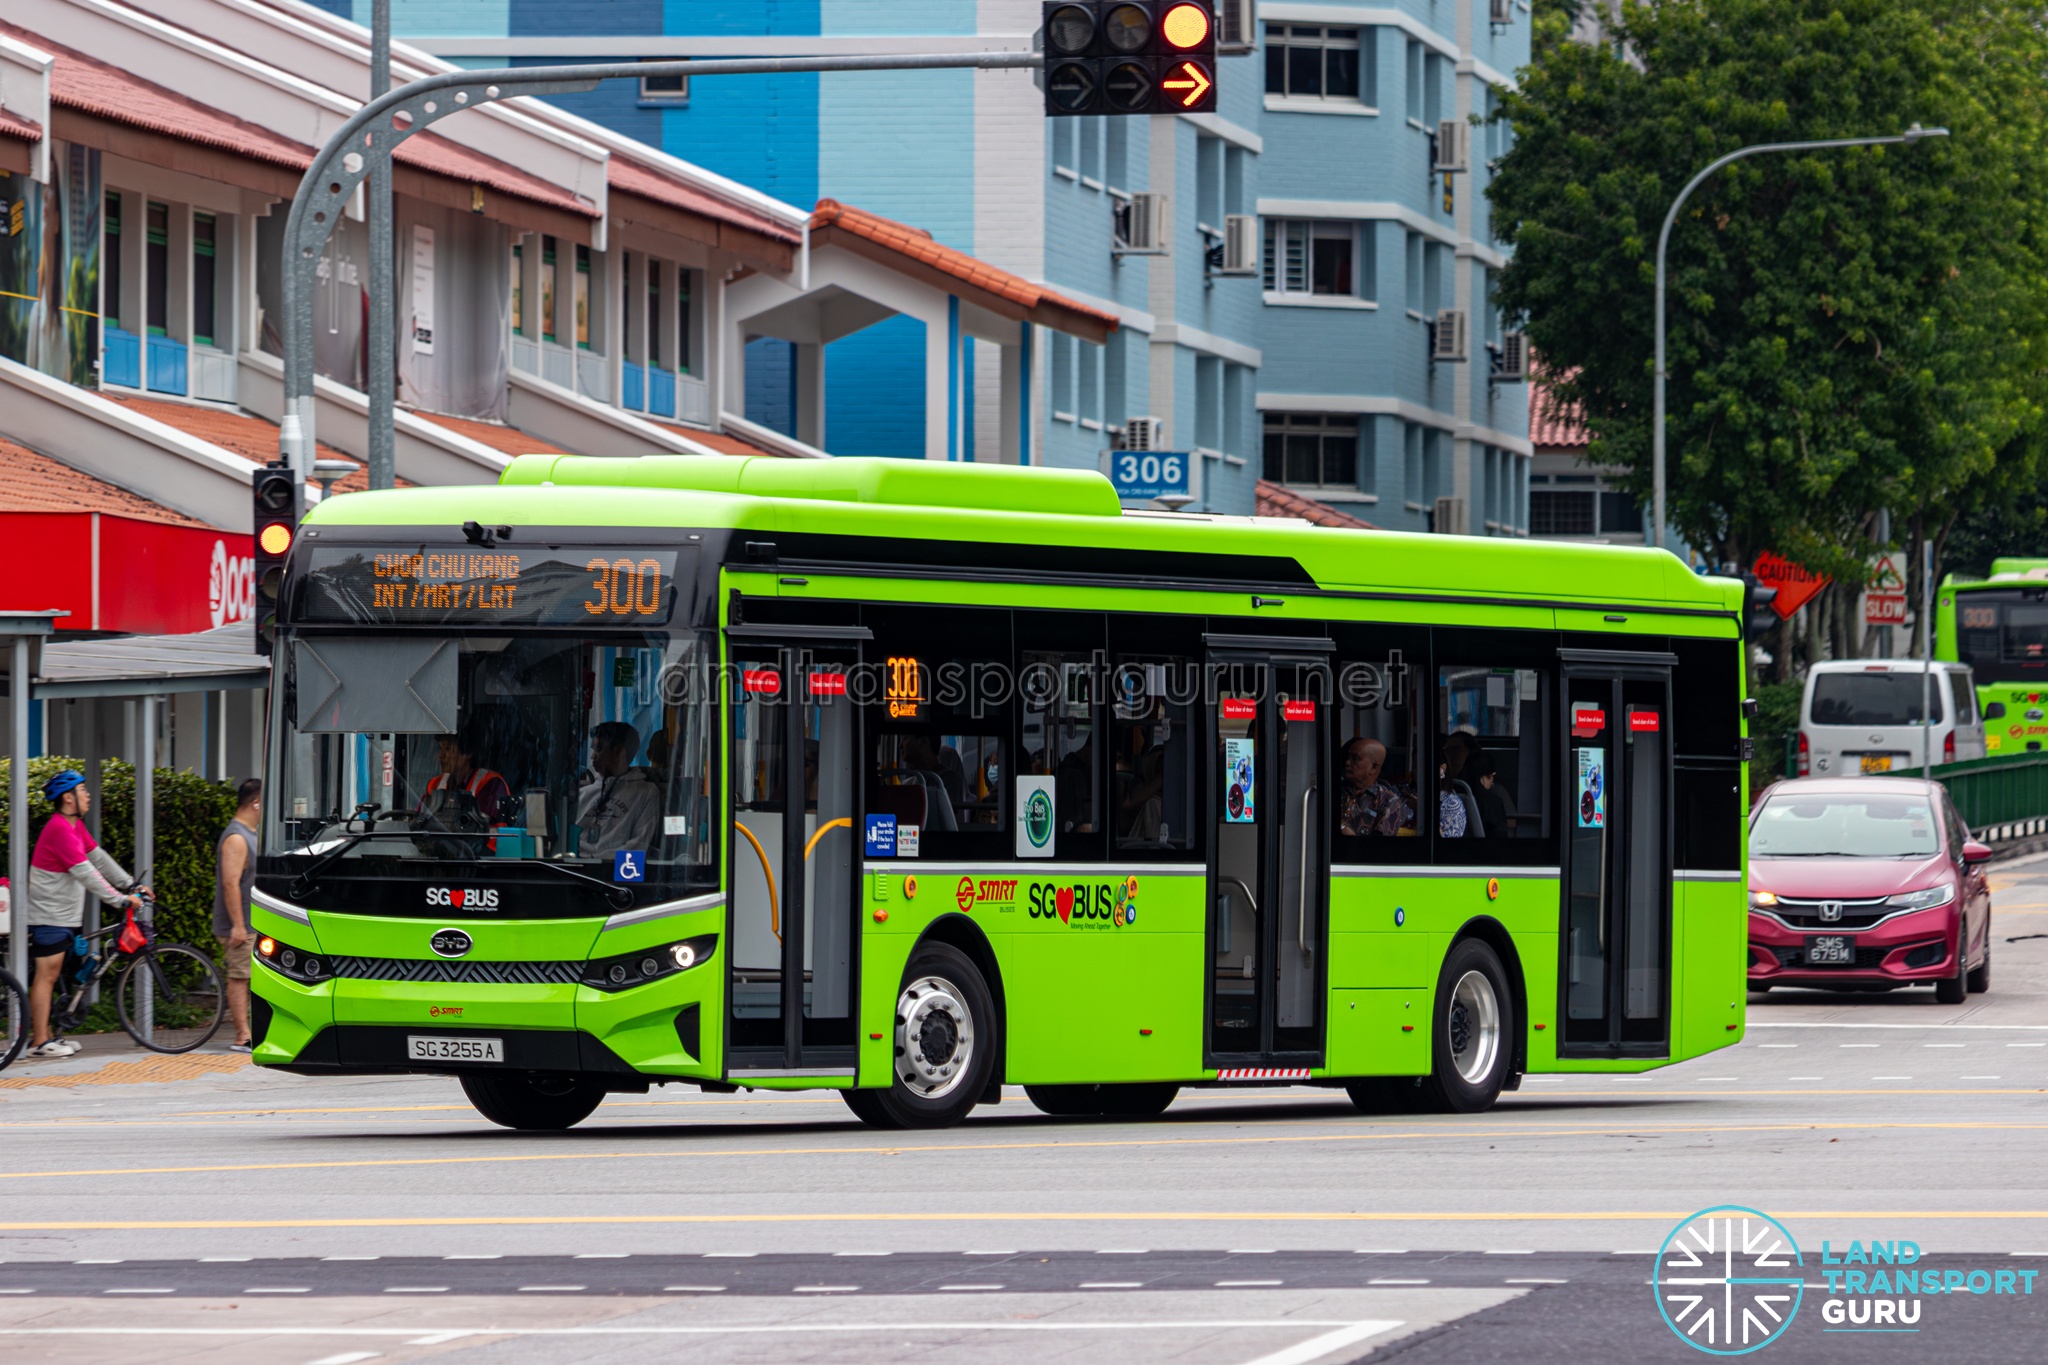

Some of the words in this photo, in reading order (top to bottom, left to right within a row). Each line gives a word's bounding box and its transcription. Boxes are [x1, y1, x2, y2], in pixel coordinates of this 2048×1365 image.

[1119, 455, 1182, 484] 306
[373, 554, 424, 578] CHOA
[427, 554, 466, 578] CHU
[469, 555, 520, 579] KANG
[585, 558, 662, 615] 300
[1867, 602, 1905, 618] SLOW
[1963, 607, 1995, 629] 300
[888, 657, 918, 697] 300
[426, 887, 451, 906] SG
[463, 888, 499, 907] BUS
[976, 880, 1018, 901] SMRT
[1028, 883, 1057, 919] SG
[1072, 884, 1112, 920] BUS
[434, 936, 468, 949] BYD
